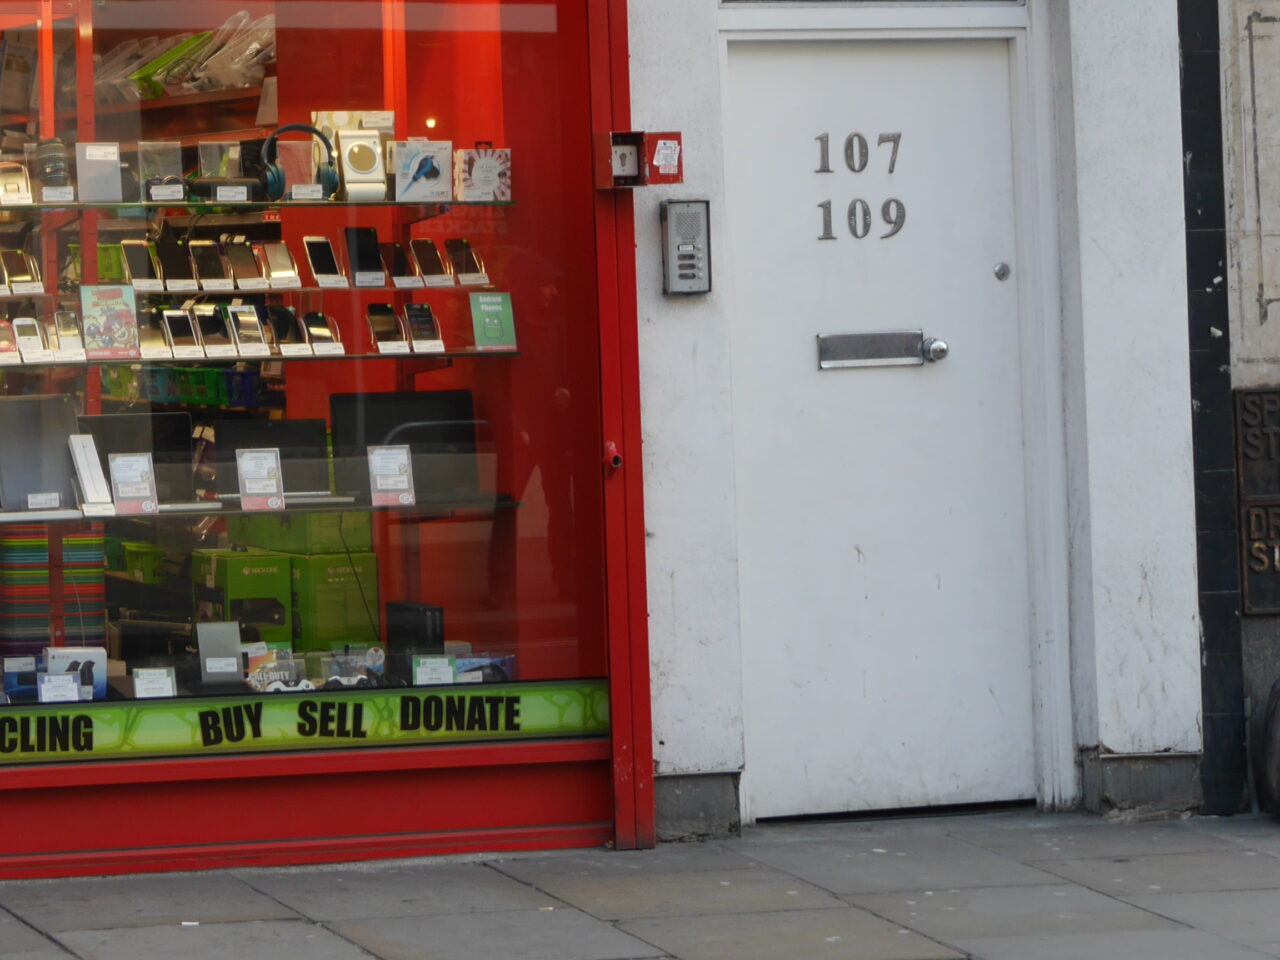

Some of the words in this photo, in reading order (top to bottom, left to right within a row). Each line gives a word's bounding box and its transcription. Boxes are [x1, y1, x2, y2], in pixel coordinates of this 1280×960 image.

[813, 131, 903, 175] 107
[816, 198, 907, 241] 109
[198, 701, 264, 747] BUY
[296, 700, 368, 738] SELL
[399, 695, 521, 732] DONATE
